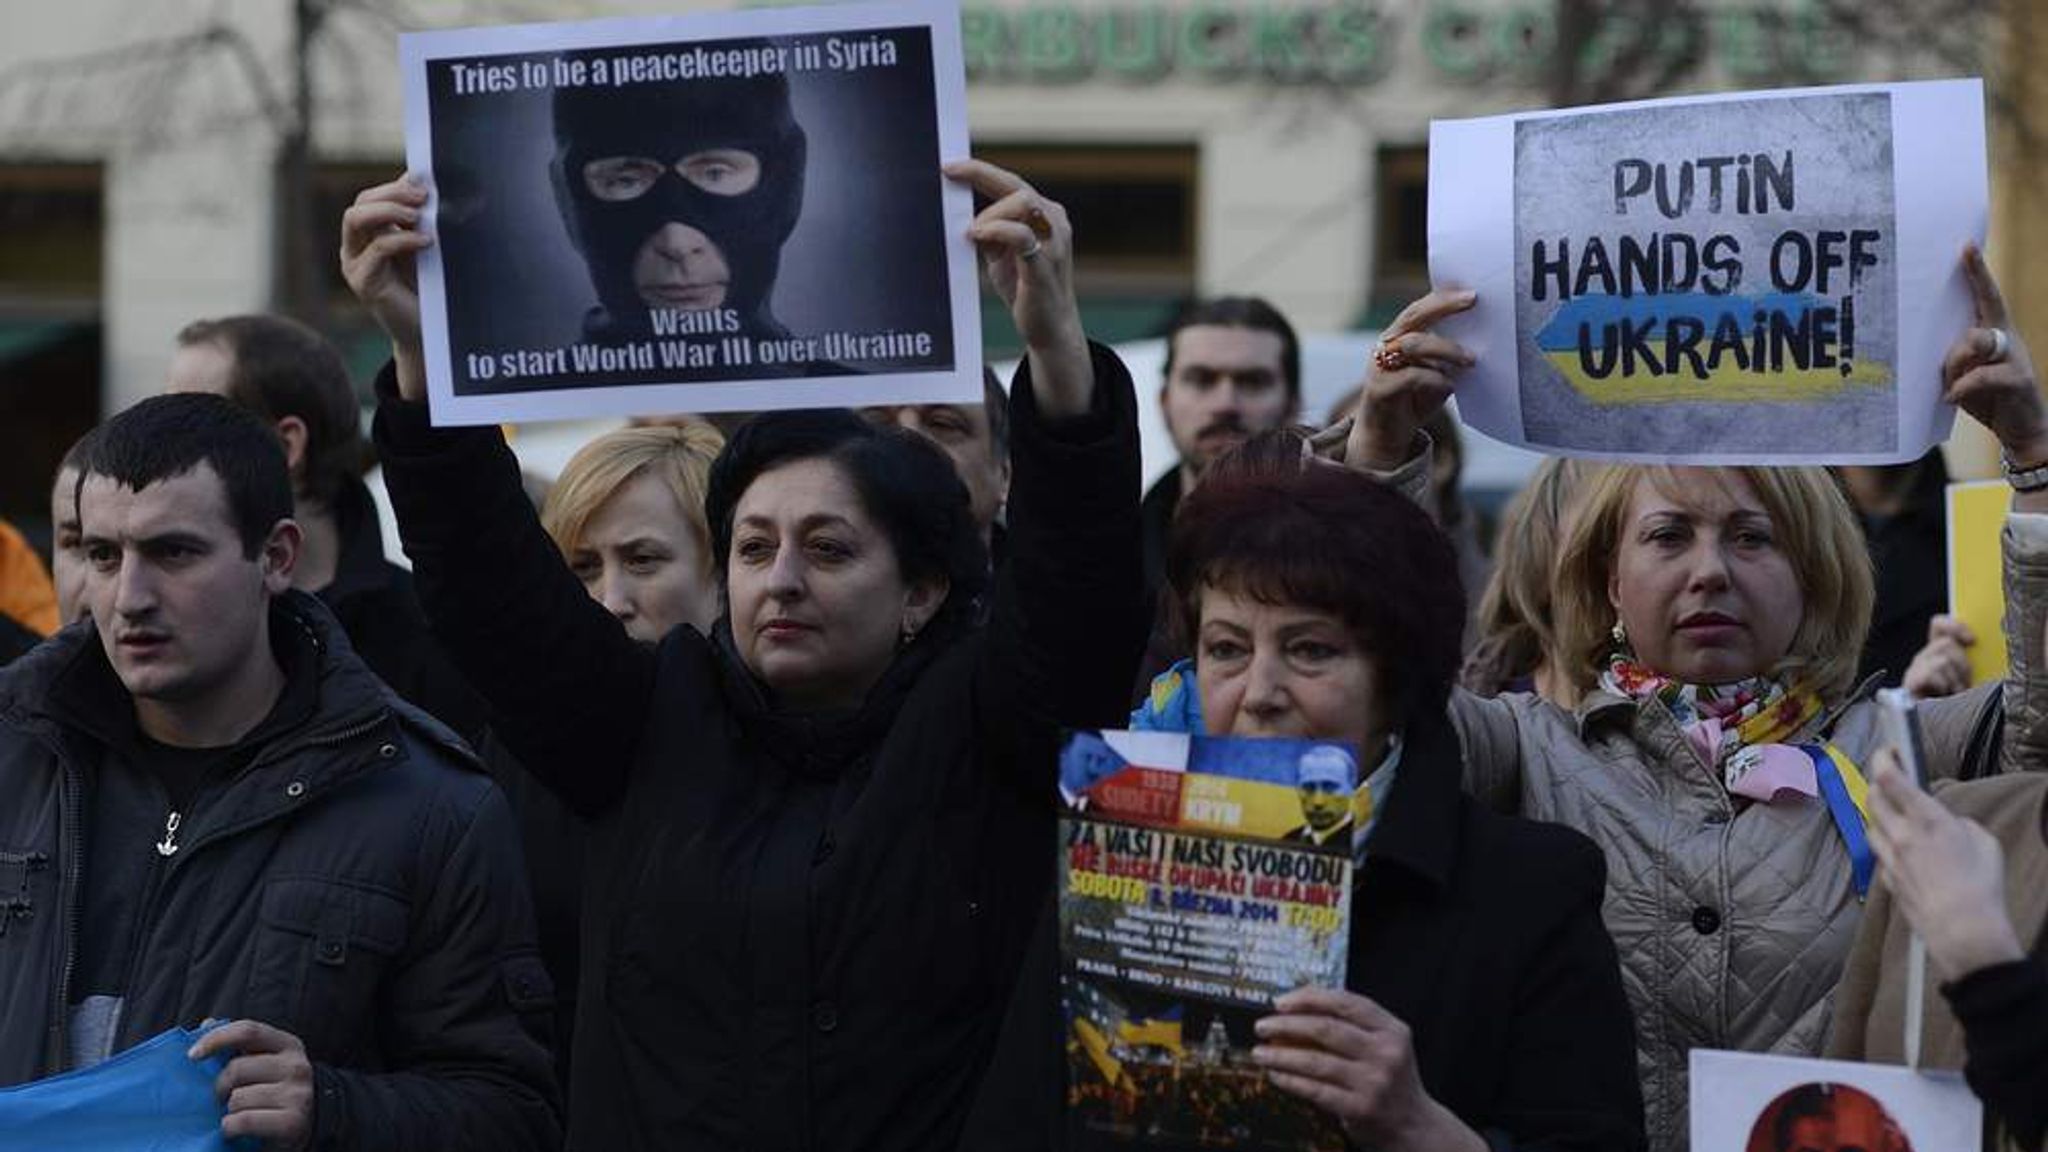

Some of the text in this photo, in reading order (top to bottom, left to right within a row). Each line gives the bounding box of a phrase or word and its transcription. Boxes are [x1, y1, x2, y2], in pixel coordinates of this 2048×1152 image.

[962, 3, 1381, 74] RBUCKS
[451, 35, 897, 95] Tries to be a peacekeeper in Syria
[1531, 229, 1881, 302] HANDS OFF
[650, 307, 740, 336] Wants
[468, 330, 932, 380] to start World War III over Ukraine
[1068, 869, 1147, 906] SOBOTA
[1231, 844, 1345, 886] SVOBODU
